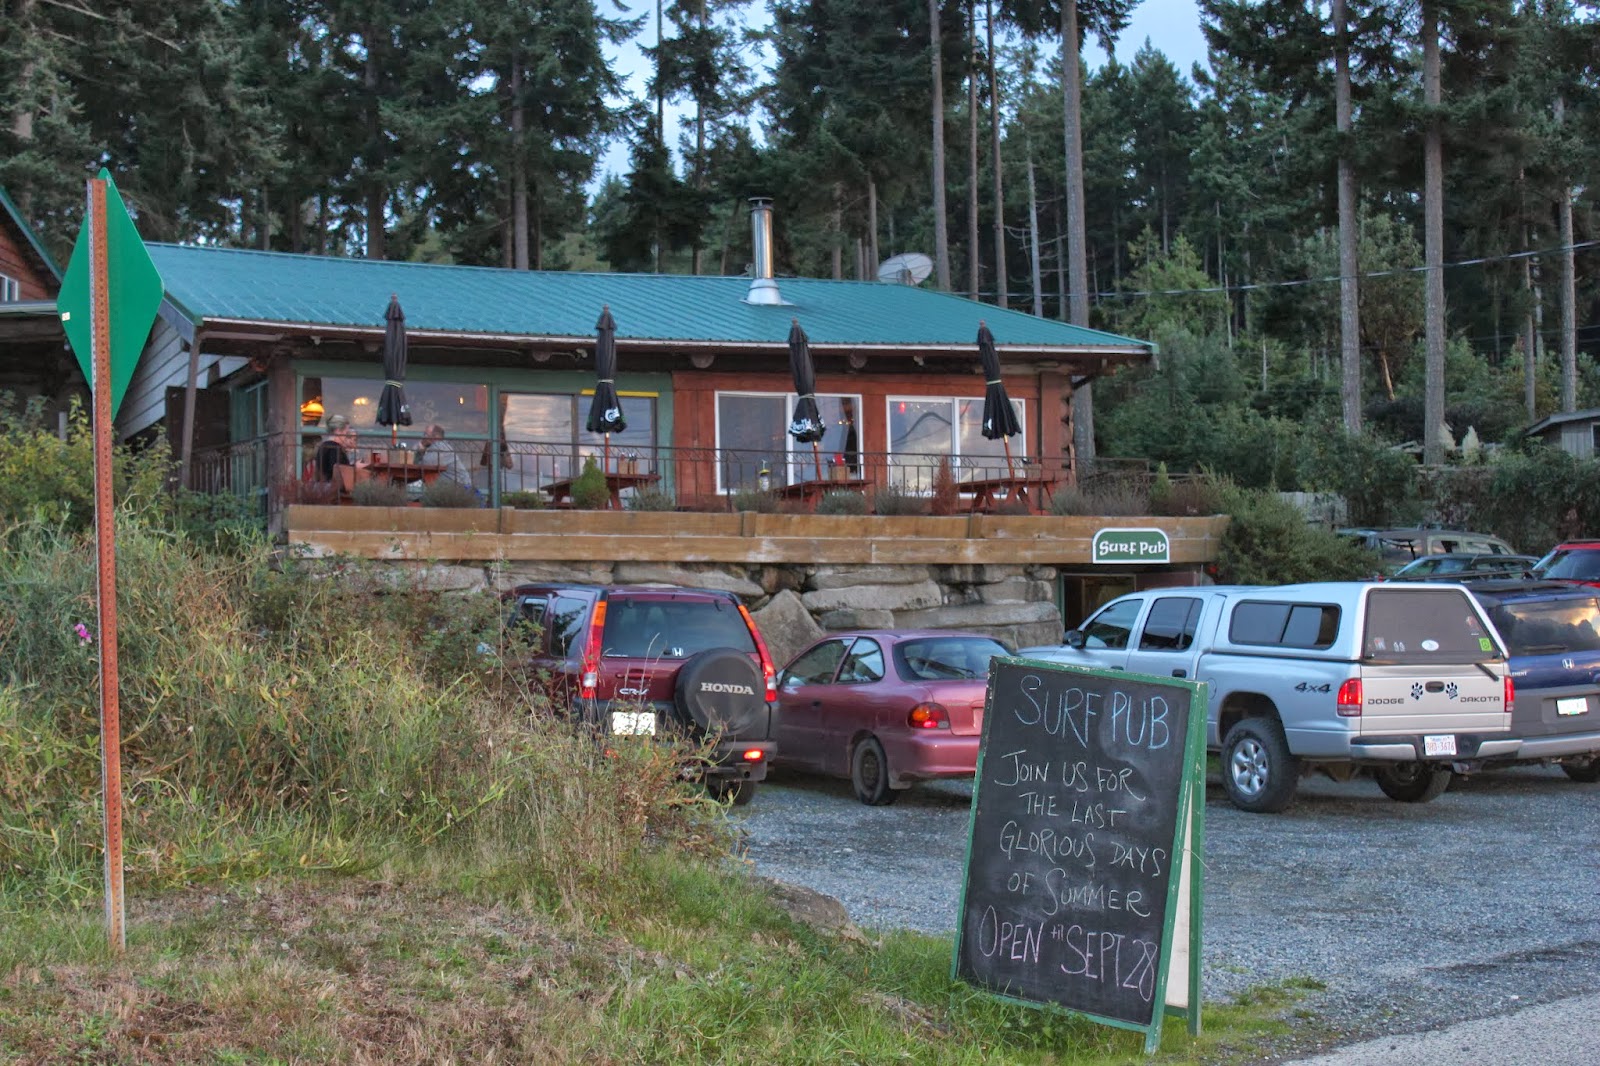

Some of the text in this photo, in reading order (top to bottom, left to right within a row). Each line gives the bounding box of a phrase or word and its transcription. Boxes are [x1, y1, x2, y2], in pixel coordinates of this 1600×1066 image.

[1099, 540, 1167, 556] Surf Pub
[700, 682, 755, 695] HONDA
[1015, 674, 1170, 750] SURF PUB
[1367, 697, 1405, 705] DODGE
[994, 749, 1146, 801] JOIN US FOR
[1018, 791, 1127, 829] THE LAST
[999, 820, 1166, 877] GLORIOUS DAYS
[1007, 867, 1151, 917] OF SUMMER
[979, 905, 1044, 964] OPEN
[1060, 925, 1126, 987] SEPT
[1122, 939, 1158, 1002] 28
